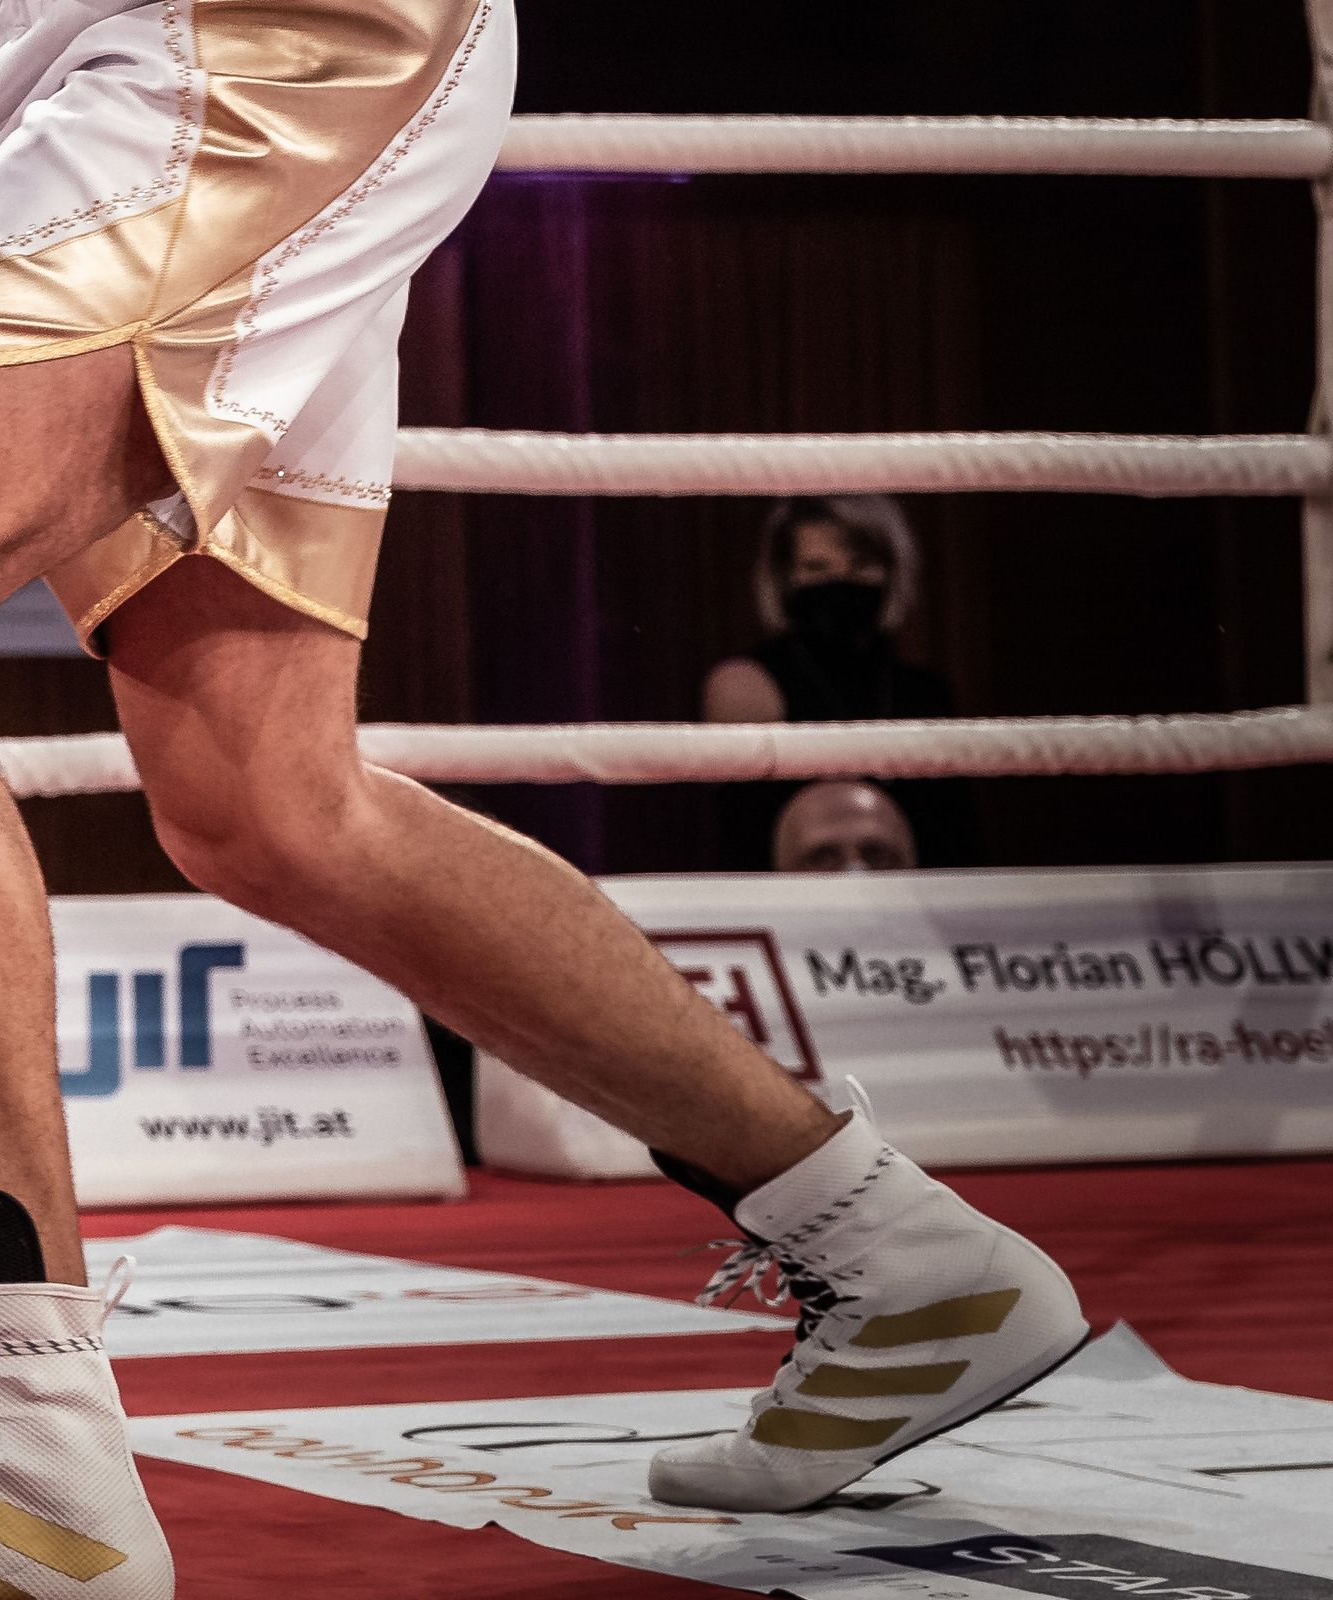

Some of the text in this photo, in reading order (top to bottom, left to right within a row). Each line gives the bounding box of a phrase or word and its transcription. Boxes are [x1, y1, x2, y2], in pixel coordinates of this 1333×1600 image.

[804, 946, 946, 1004] Mag.
[950, 941, 1145, 992] Florian
[139, 1105, 354, 1144] www.jit.at
